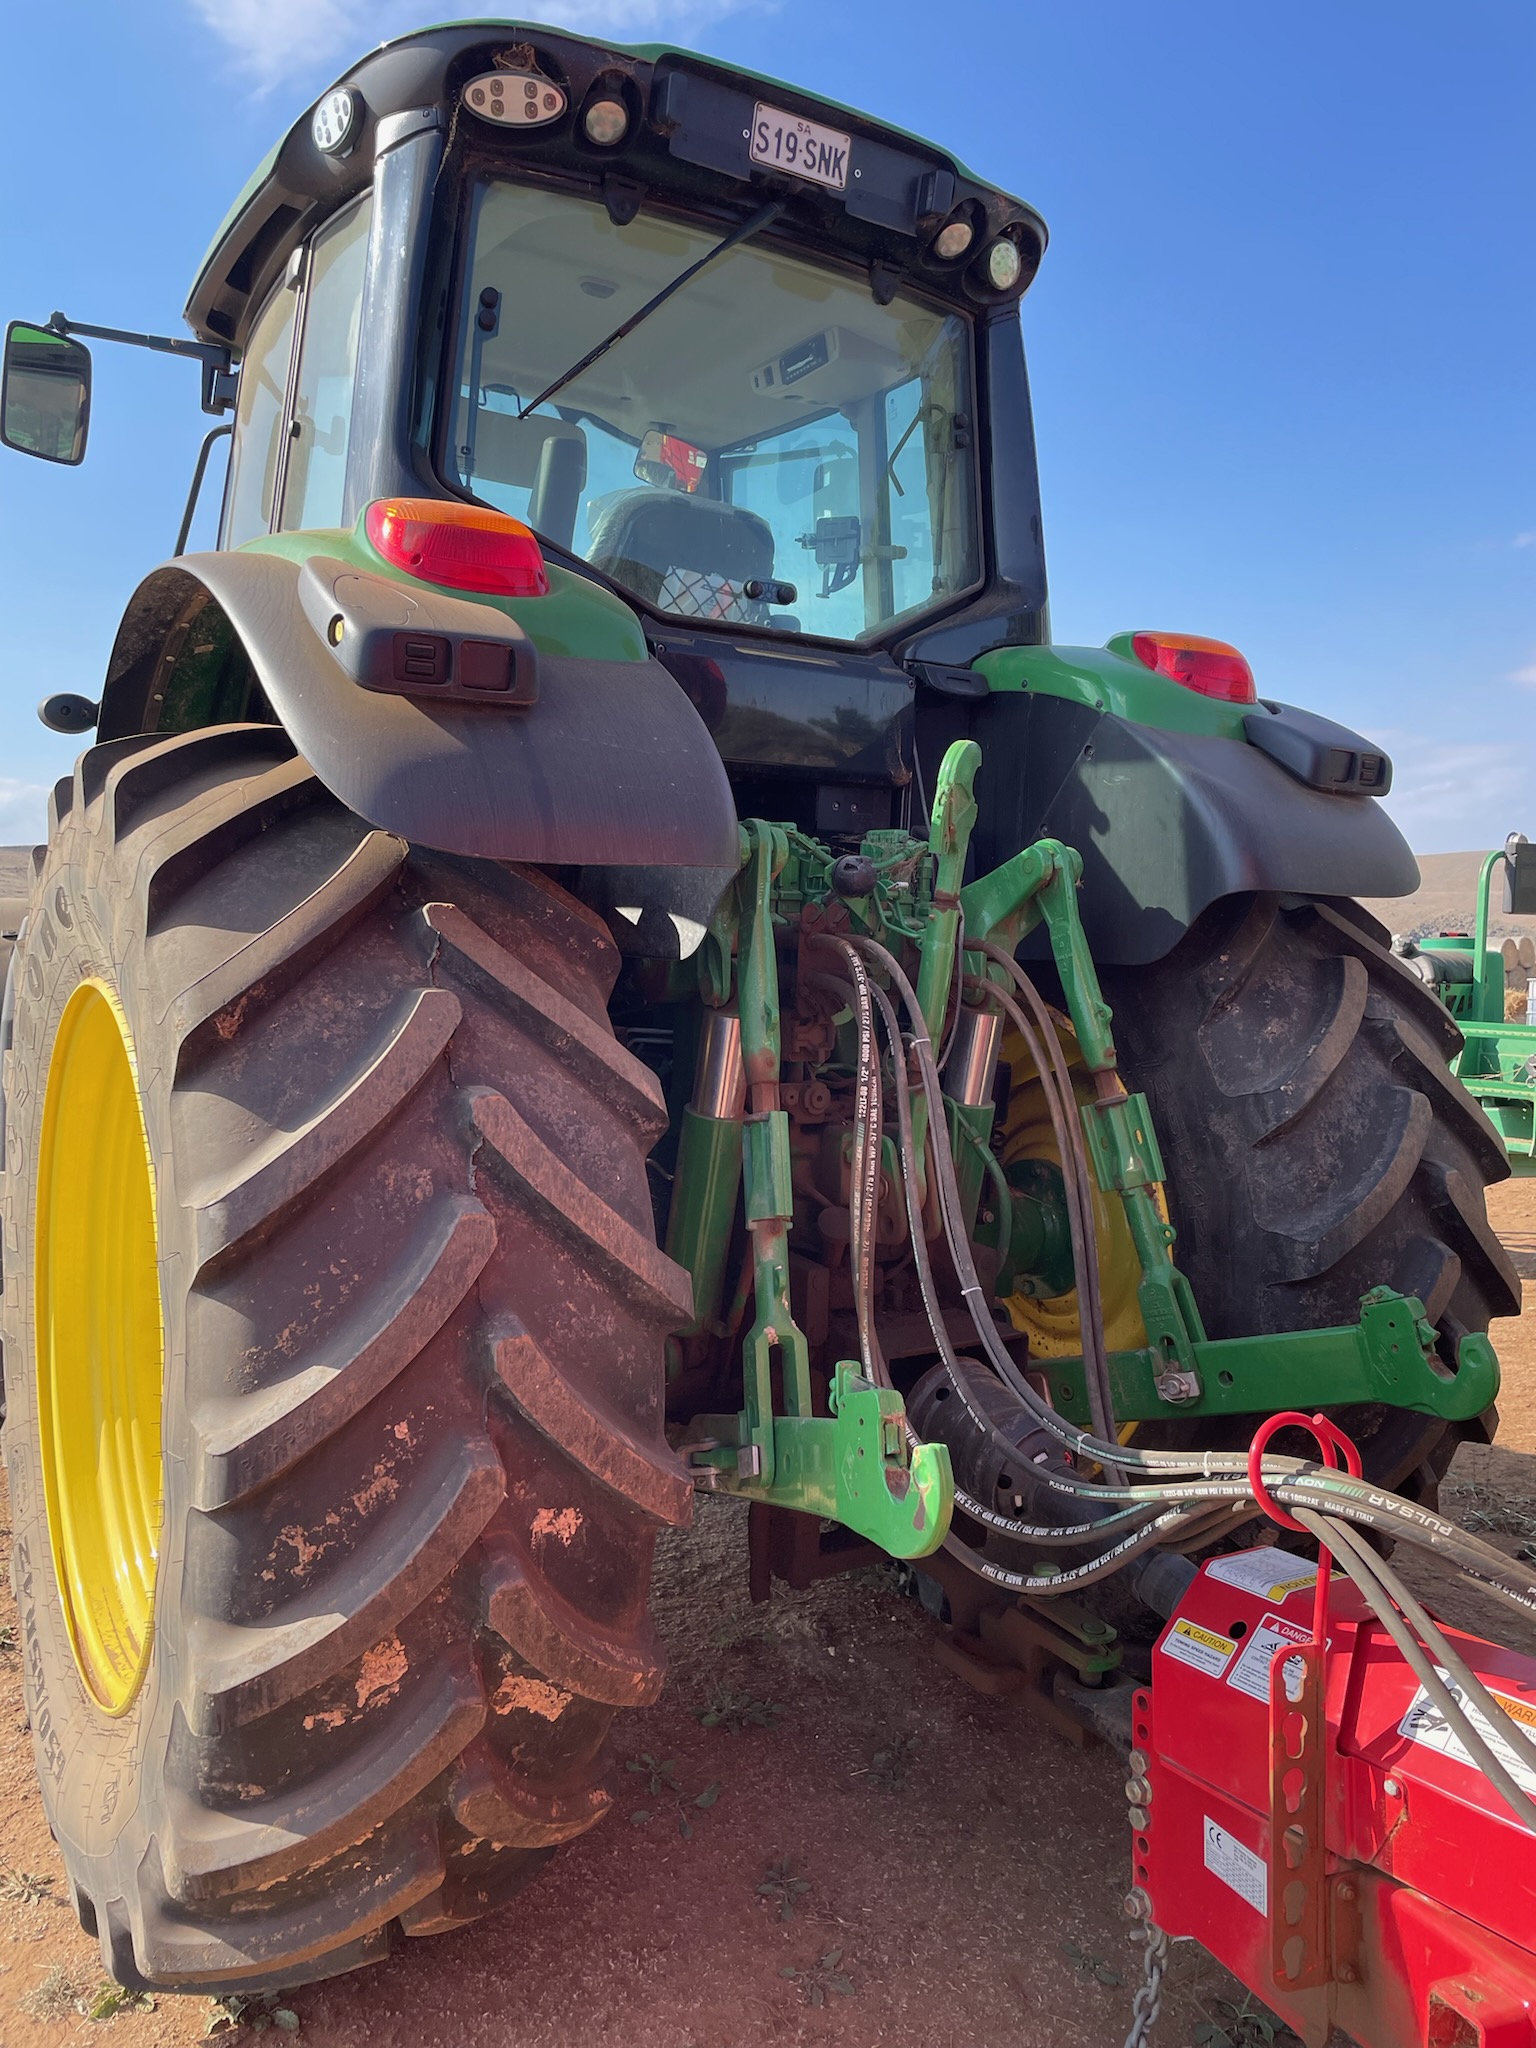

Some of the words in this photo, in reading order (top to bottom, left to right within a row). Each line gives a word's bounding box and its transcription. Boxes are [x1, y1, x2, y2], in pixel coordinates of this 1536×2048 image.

[797, 122, 811, 135] SA
[862, 1030, 870, 1043] PSI
[862, 1043, 870, 1063] 4000
[868, 1146, 876, 1159] WP
[866, 1177, 874, 1193] 275
[1049, 1480, 1074, 1494] PULSAR
[1287, 1476, 1326, 1488] NOVA
[1277, 1490, 1289, 1499] SAE
[1290, 1492, 1319, 1506] 100R2AT
[1324, 1501, 1345, 1514] MADE
[1345, 1508, 1354, 1518] IN
[1356, 1511, 1375, 1523] ITALY
[981, 1511, 994, 1522] WP
[1368, 1493, 1453, 1536] PULSAR
[1022, 1524, 1034, 1535] PSI
[1005, 1573, 1023, 1586] MADE
[1193, 1631, 1228, 1651] CAUTION
[1281, 1626, 1313, 1644] DANGE
[1209, 1826, 1222, 1849] CE
